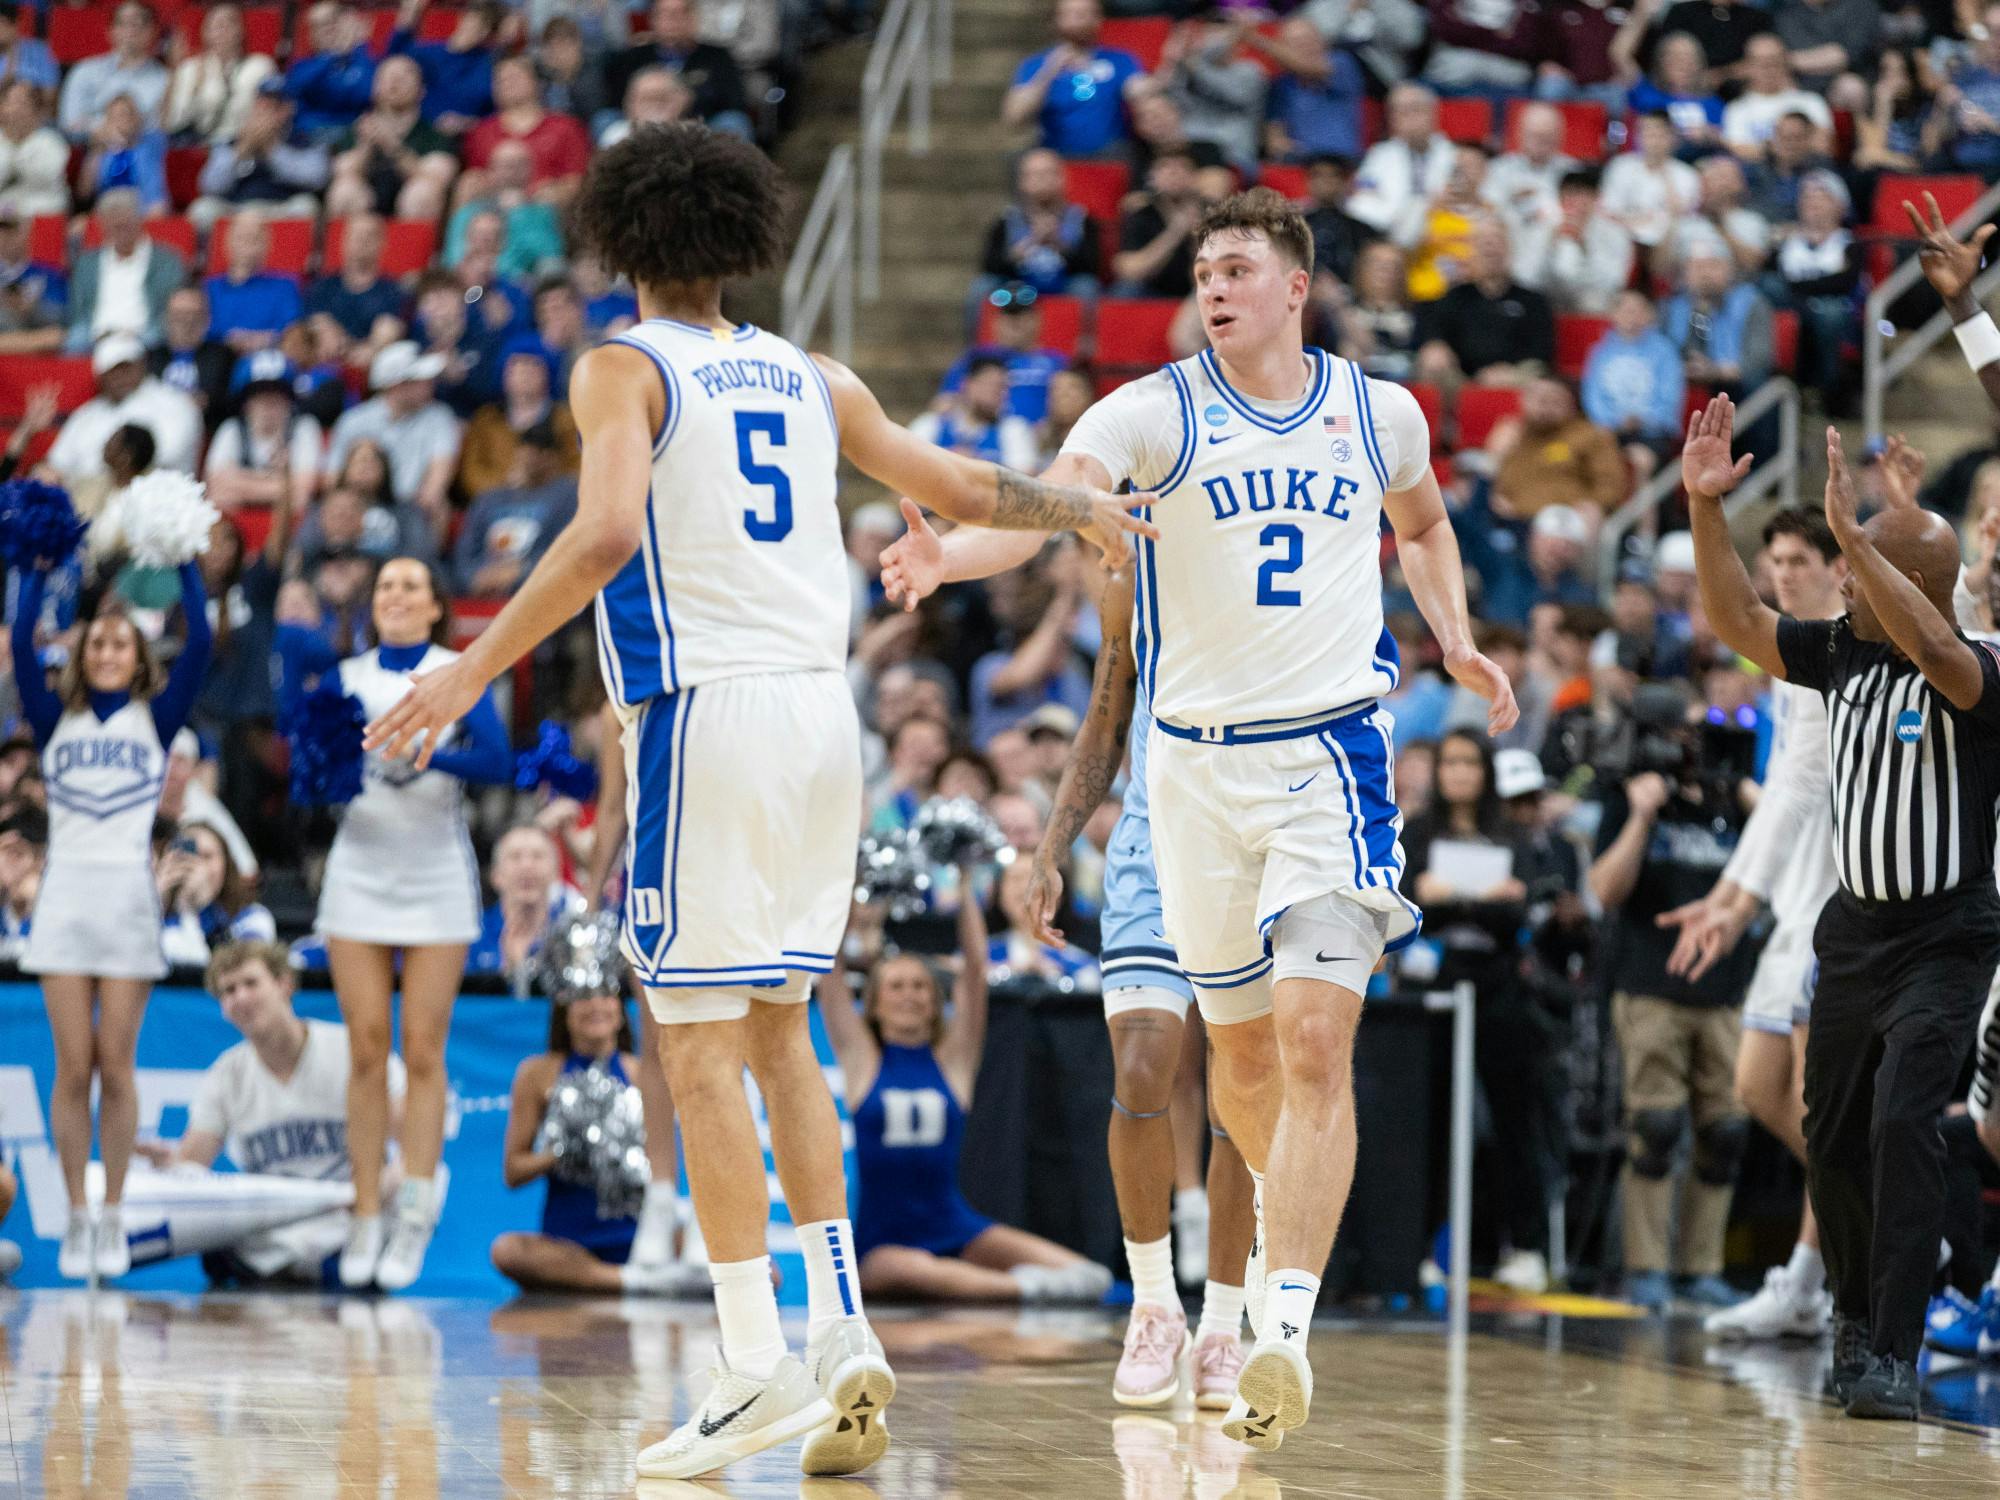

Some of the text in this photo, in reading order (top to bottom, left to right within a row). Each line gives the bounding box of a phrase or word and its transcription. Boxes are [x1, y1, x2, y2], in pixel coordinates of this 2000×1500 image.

[692, 359, 803, 401] PROCTOR
[733, 410, 793, 542] 5
[1201, 468, 1359, 521] DUKE
[1256, 523, 1303, 606] 2
[55, 738, 150, 779] DUKE
[633, 887, 663, 926] D
[881, 1088, 947, 1148] D
